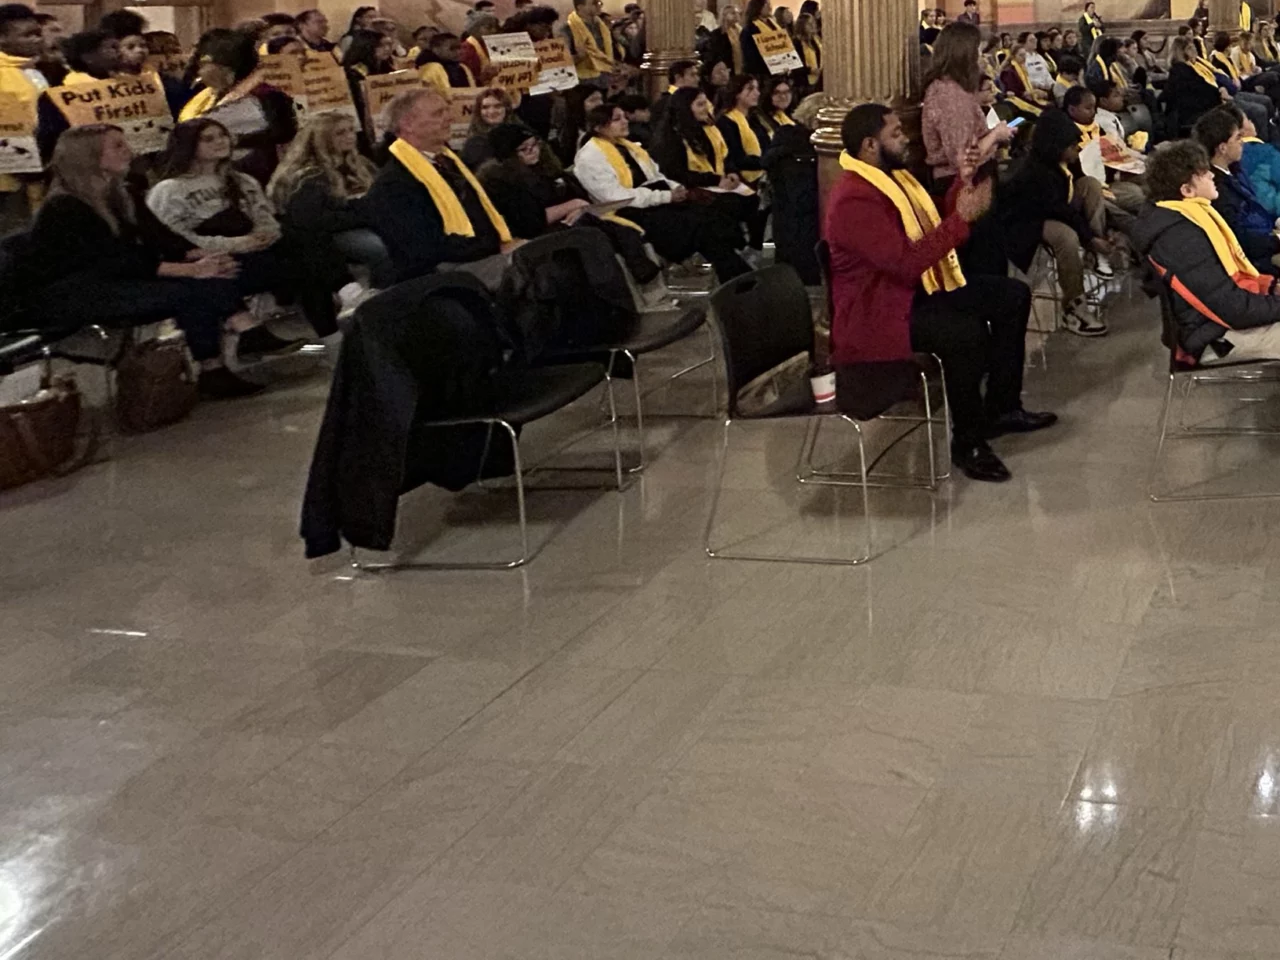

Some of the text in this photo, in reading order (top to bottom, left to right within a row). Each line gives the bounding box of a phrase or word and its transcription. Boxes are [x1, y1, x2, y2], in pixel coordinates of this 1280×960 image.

[60, 79, 156, 106] Put Kids
[94, 100, 148, 121] First!
